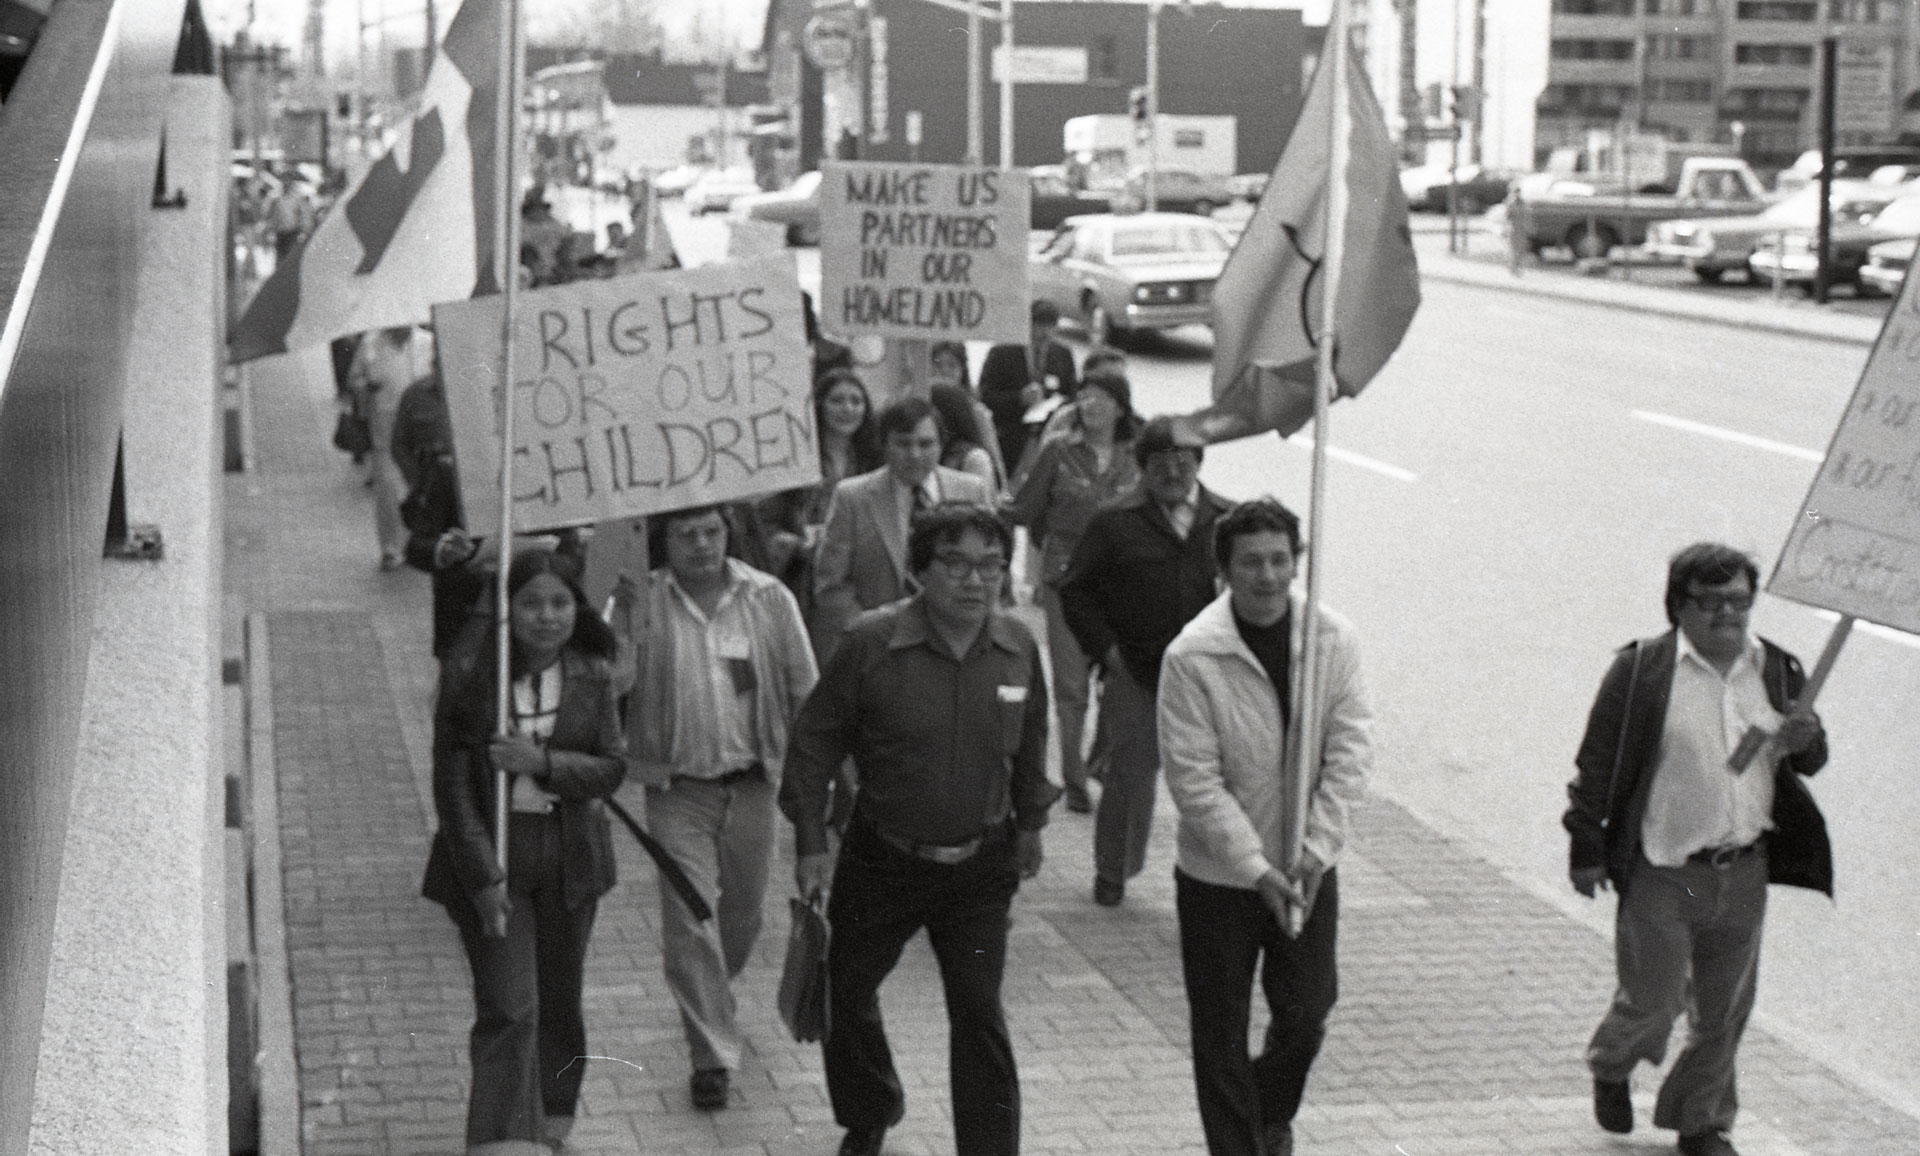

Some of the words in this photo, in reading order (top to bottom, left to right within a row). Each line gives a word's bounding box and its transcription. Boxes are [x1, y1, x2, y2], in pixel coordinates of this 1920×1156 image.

[846, 170, 932, 205] MAKE
[957, 171, 999, 206] US
[860, 211, 996, 249] PARTNERS
[861, 250, 888, 279] IN
[922, 253, 972, 283] OUR
[843, 286, 987, 329] HOMELAND
[538, 287, 774, 372] RIGHTS
[492, 373, 617, 436] FOR
[658, 350, 790, 412] OUR
[500, 406, 813, 506] CHILDREN
